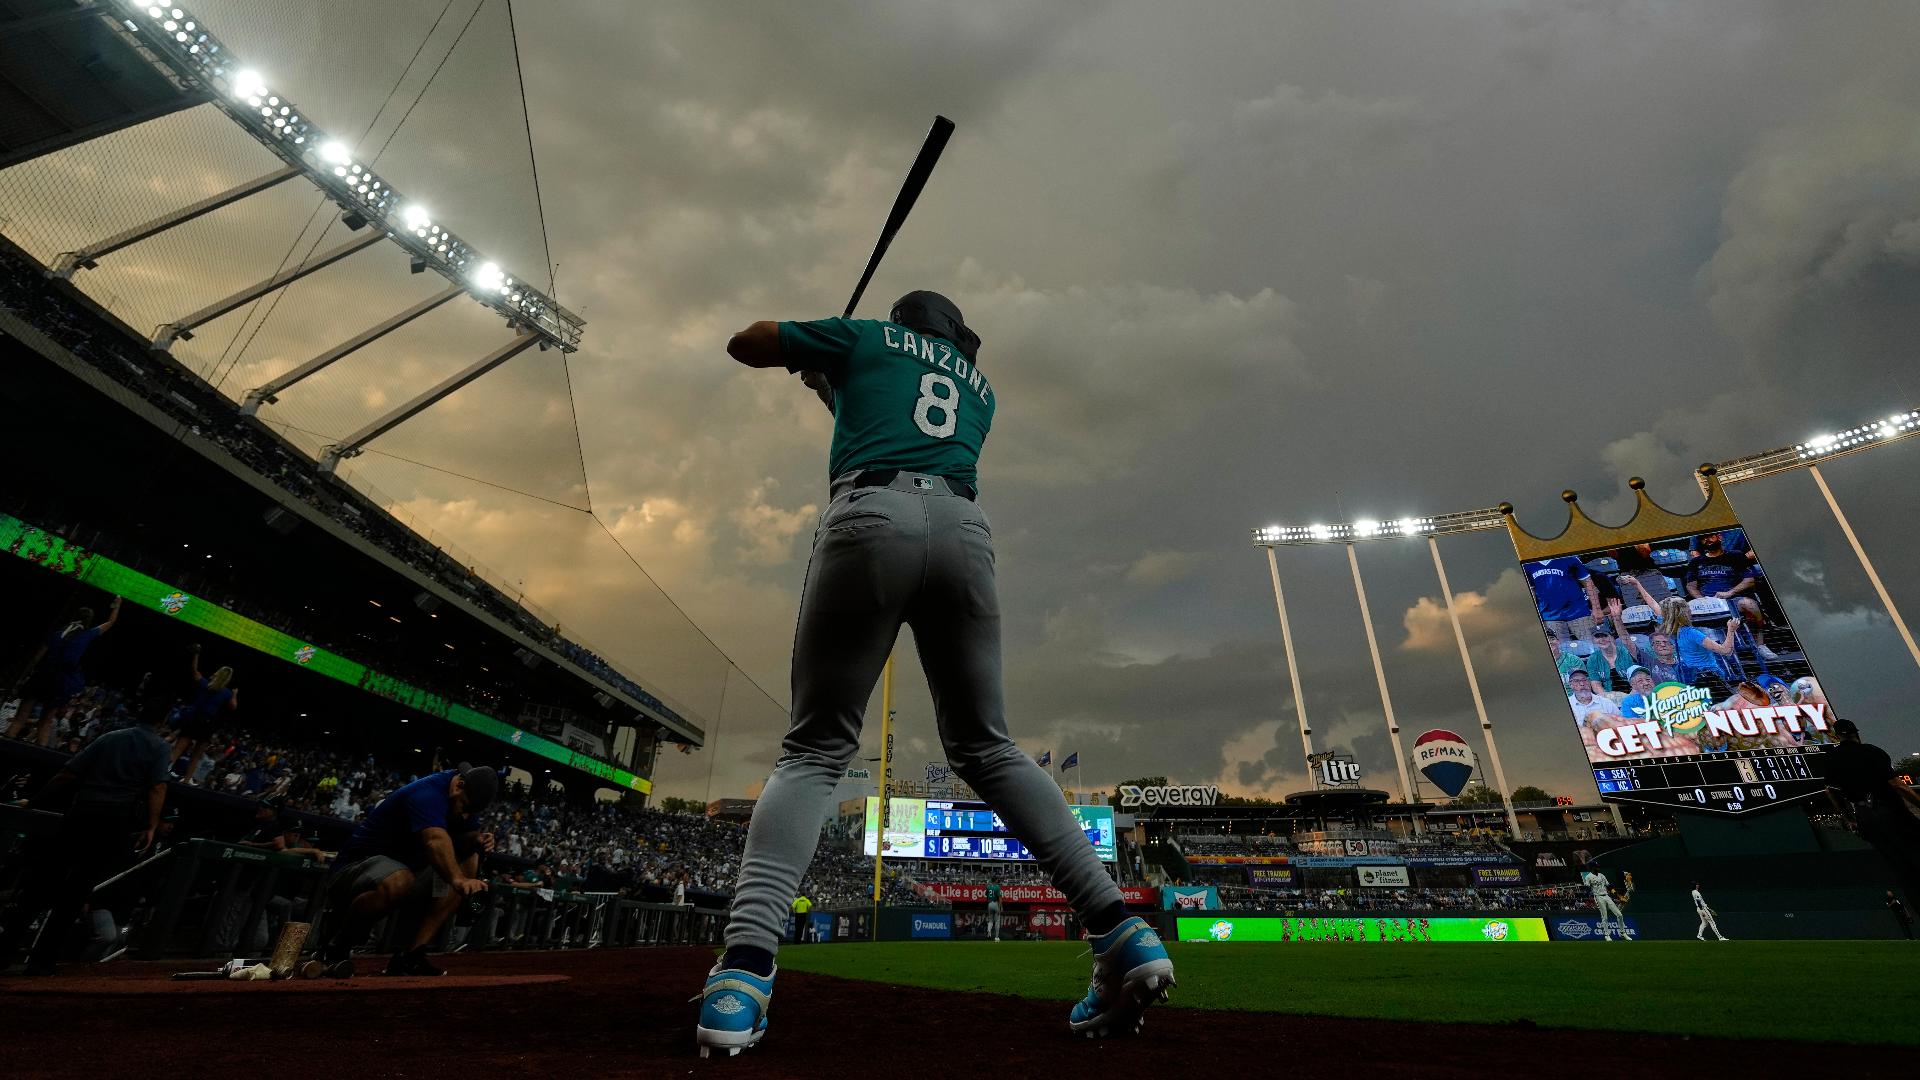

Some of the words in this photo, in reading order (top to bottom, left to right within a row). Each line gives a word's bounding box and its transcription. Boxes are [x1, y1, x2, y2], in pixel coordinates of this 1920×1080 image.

[883, 326, 992, 406] CANZONE
[912, 372, 960, 439] 8
[1532, 569, 1551, 580] KANSAS
[1552, 568, 1564, 577] CITY
[1638, 685, 1711, 722] Hampton
[1663, 703, 1710, 737] Farms
[1596, 721, 1663, 757] GET
[1702, 704, 1829, 738] NUTTY
[1421, 747, 1466, 761] RE/MAX
[1804, 745, 1822, 753] PITCH
[847, 769, 869, 779] Bank
[1321, 760, 1361, 787] Lite
[1611, 769, 1627, 780] SEA
[1631, 769, 1638, 778] 2
[1741, 760, 1749, 769] 2
[1754, 759, 1762, 769] 2
[1767, 758, 1775, 768] 0
[1781, 757, 1788, 767] 1
[1795, 756, 1802, 766] 4
[1618, 781, 1629, 791] KC
[1634, 780, 1641, 789] 0
[1746, 772, 1753, 782] 0
[1760, 770, 1766, 780] 1
[1772, 769, 1780, 780] 0
[1785, 768, 1793, 779] 1
[1800, 768, 1807, 778] 4
[1143, 786, 1217, 806] evergy
[1678, 793, 1695, 802] BALL
[1695, 788, 1707, 804] 0
[1710, 790, 1734, 800] STRIKE
[1733, 786, 1746, 802] 0
[1751, 788, 1765, 798] OUT
[1764, 784, 1777, 800] 0
[944, 816, 951, 829] 0
[957, 816, 962, 829] 1
[969, 816, 975, 830] 1
[942, 837, 950, 853] 8
[980, 838, 992, 854] 10
[1375, 870, 1399, 879] planet
[1478, 869, 1492, 877] FREE
[1493, 868, 1520, 877] TRAINING
[940, 885, 961, 897] Like
[963, 890, 970, 898] a
[971, 889, 987, 900] goo
[1178, 897, 1204, 906] SONIC
[922, 922, 948, 931] FANDUEL
